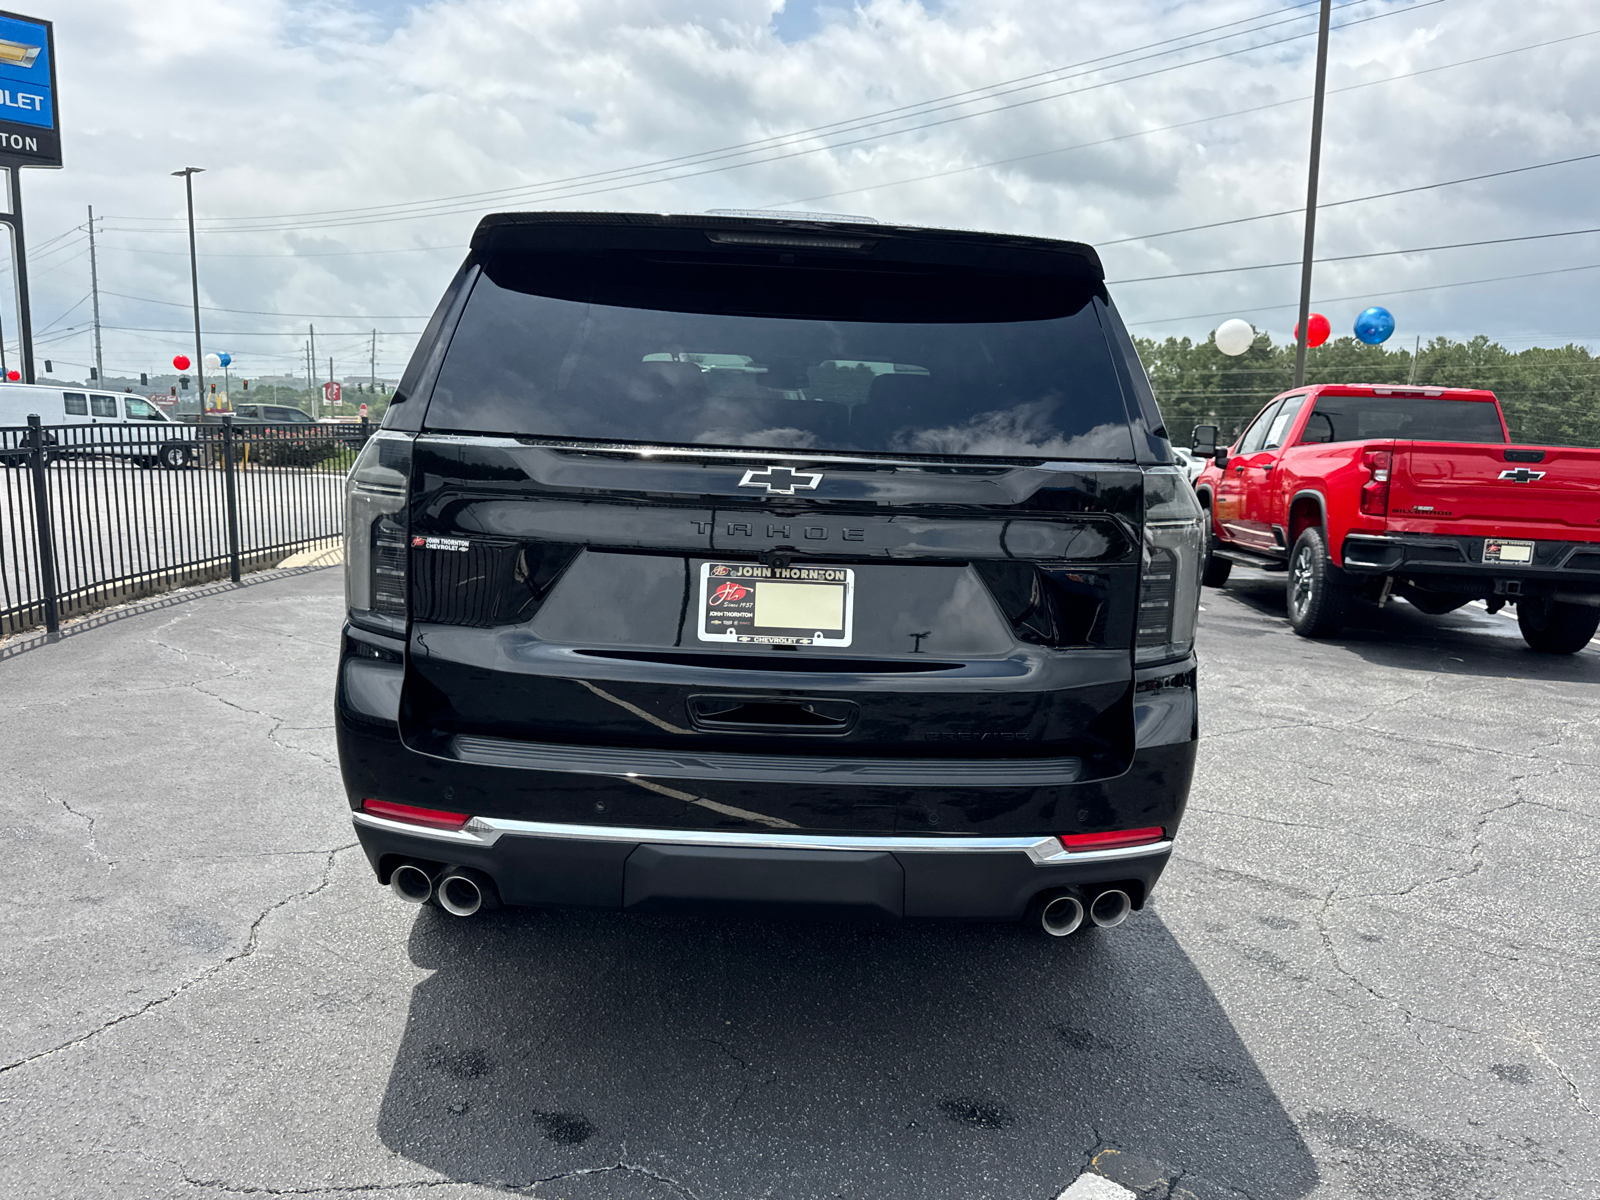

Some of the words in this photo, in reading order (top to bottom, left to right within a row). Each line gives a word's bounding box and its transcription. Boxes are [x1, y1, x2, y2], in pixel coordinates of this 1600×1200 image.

[0, 89, 44, 111] LET
[690, 520, 865, 541] TAHOE
[440, 538, 470, 547] THORNTON
[737, 566, 771, 577] JOHN
[775, 568, 844, 580] THORNTON
[753, 636, 797, 644] CHEVROLET
[924, 732, 1030, 740] PREMIER
